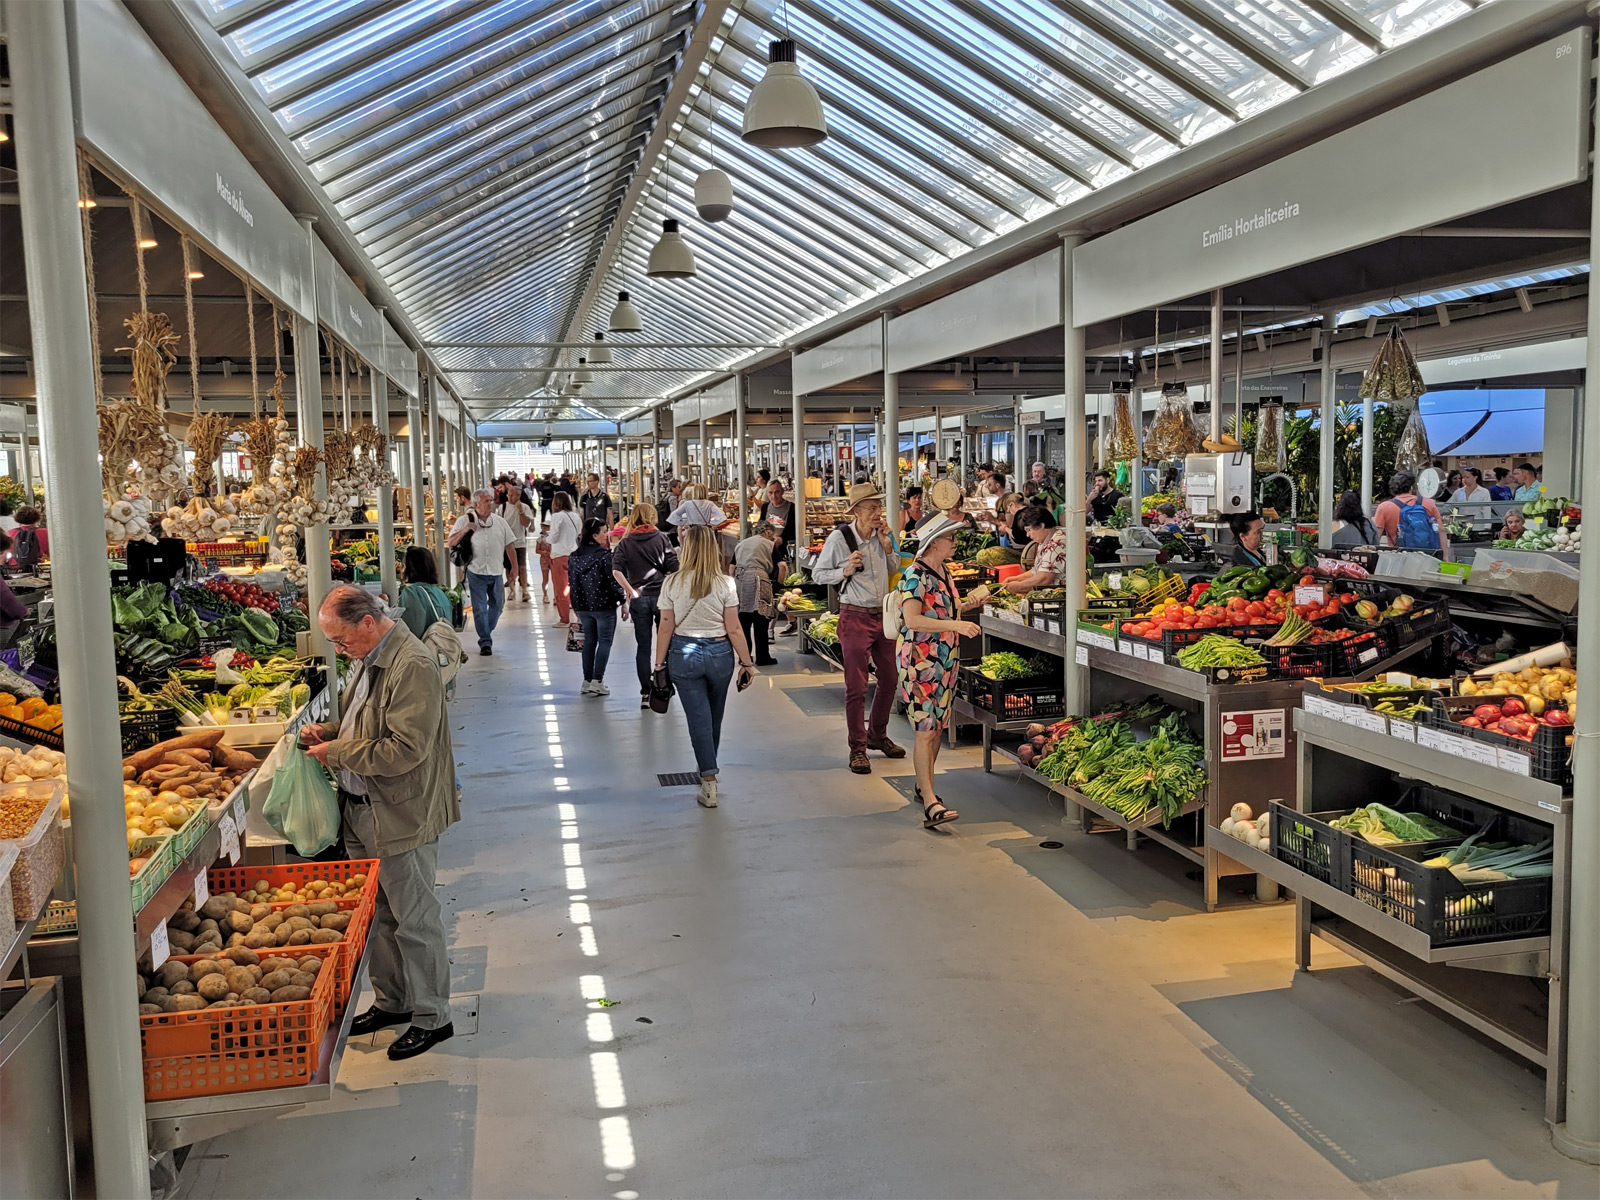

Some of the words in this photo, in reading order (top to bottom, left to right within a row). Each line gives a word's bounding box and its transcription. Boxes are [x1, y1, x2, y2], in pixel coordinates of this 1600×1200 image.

[1555, 43, 1571, 59] B96
[216, 172, 231, 206] Maria
[232, 190, 238, 212] do
[1202, 223, 1233, 248] Emília
[1234, 201, 1300, 237] Hortaliceira
[1447, 356, 1472, 367] Legumes
[1472, 353, 1480, 363] da
[1480, 350, 1502, 362] Tininha
